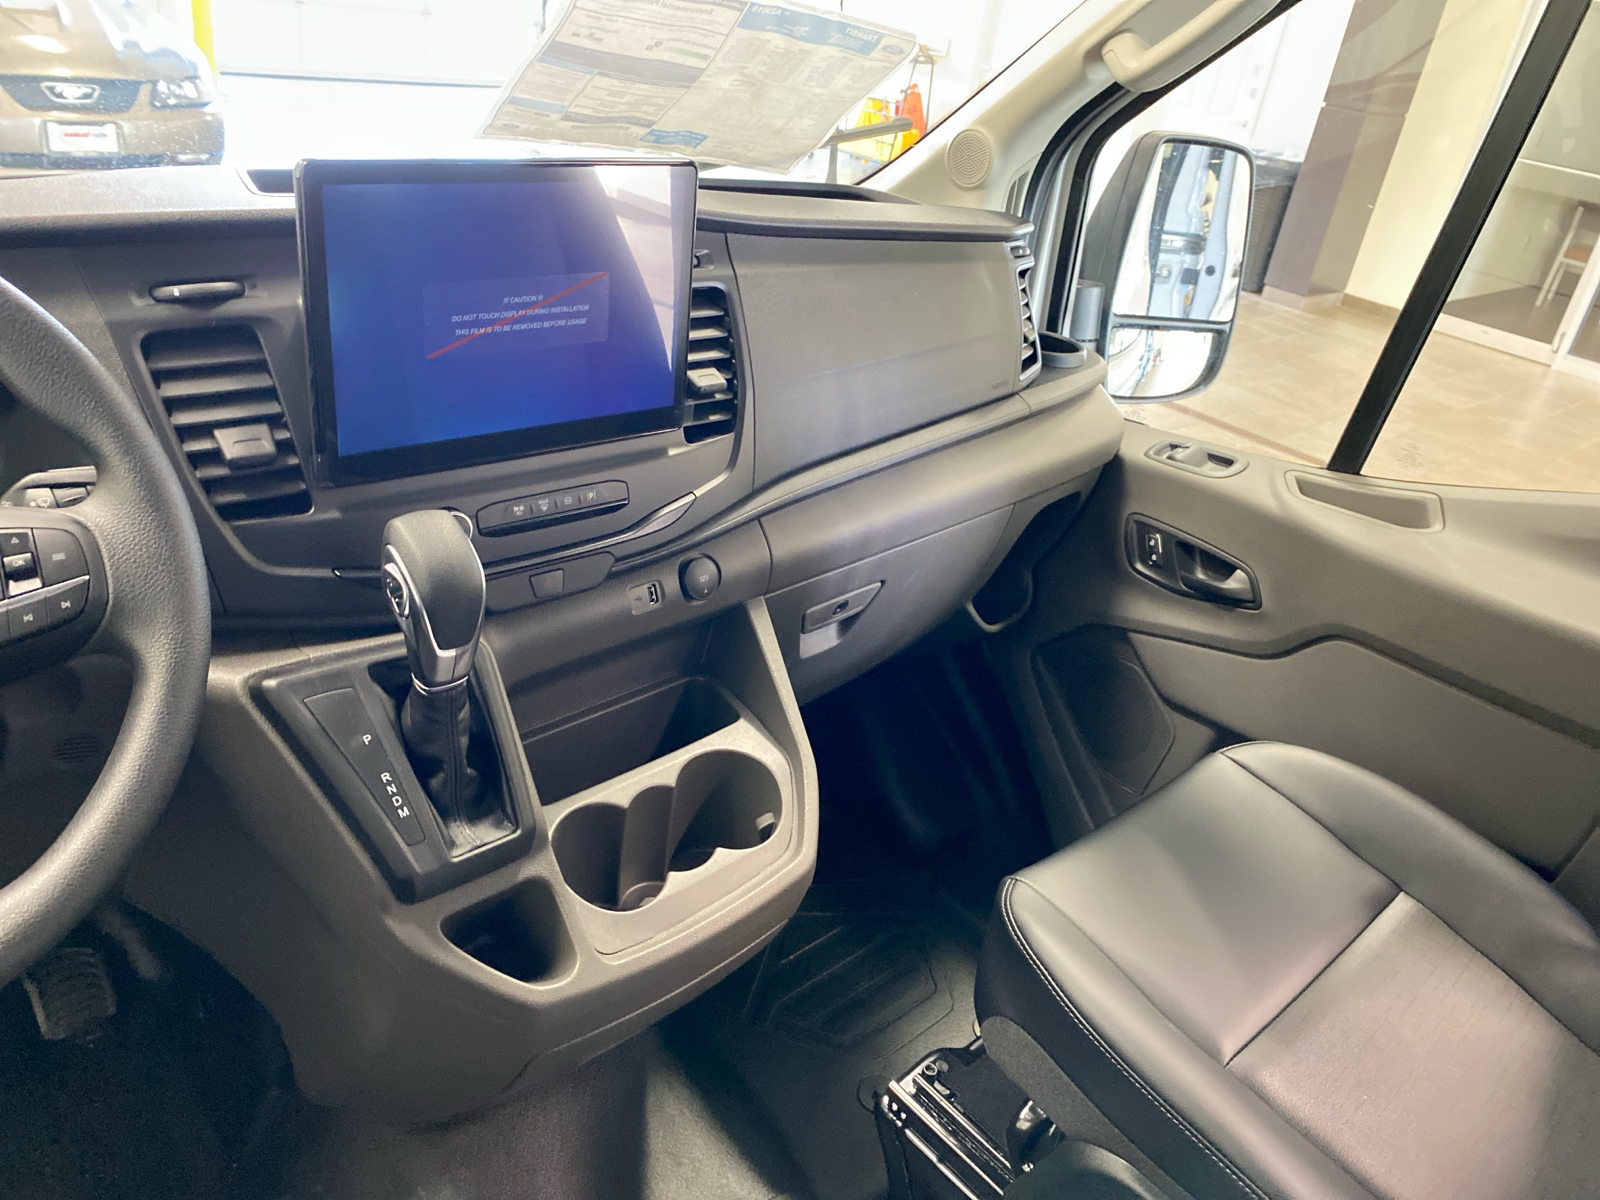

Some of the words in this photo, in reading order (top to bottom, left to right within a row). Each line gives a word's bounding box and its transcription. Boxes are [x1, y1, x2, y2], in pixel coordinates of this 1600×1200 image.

[509, 295, 537, 304] CAUTION
[462, 313, 476, 321] NOT
[478, 312, 500, 320] TOUCH
[500, 309, 527, 319] DISPLAY
[526, 307, 550, 316] DURING
[550, 304, 590, 314] INSTALLATION
[470, 327, 486, 335] FILM
[512, 322, 543, 331] REMOVED
[543, 320, 567, 328] BEFORE
[567, 317, 588, 326] USAGE
[699, 573, 710, 583] 12V
[362, 734, 372, 745] P
[380, 772, 392, 783] R
[386, 783, 397, 795] N
[392, 796, 402, 807] D
[397, 806, 410, 819] M
